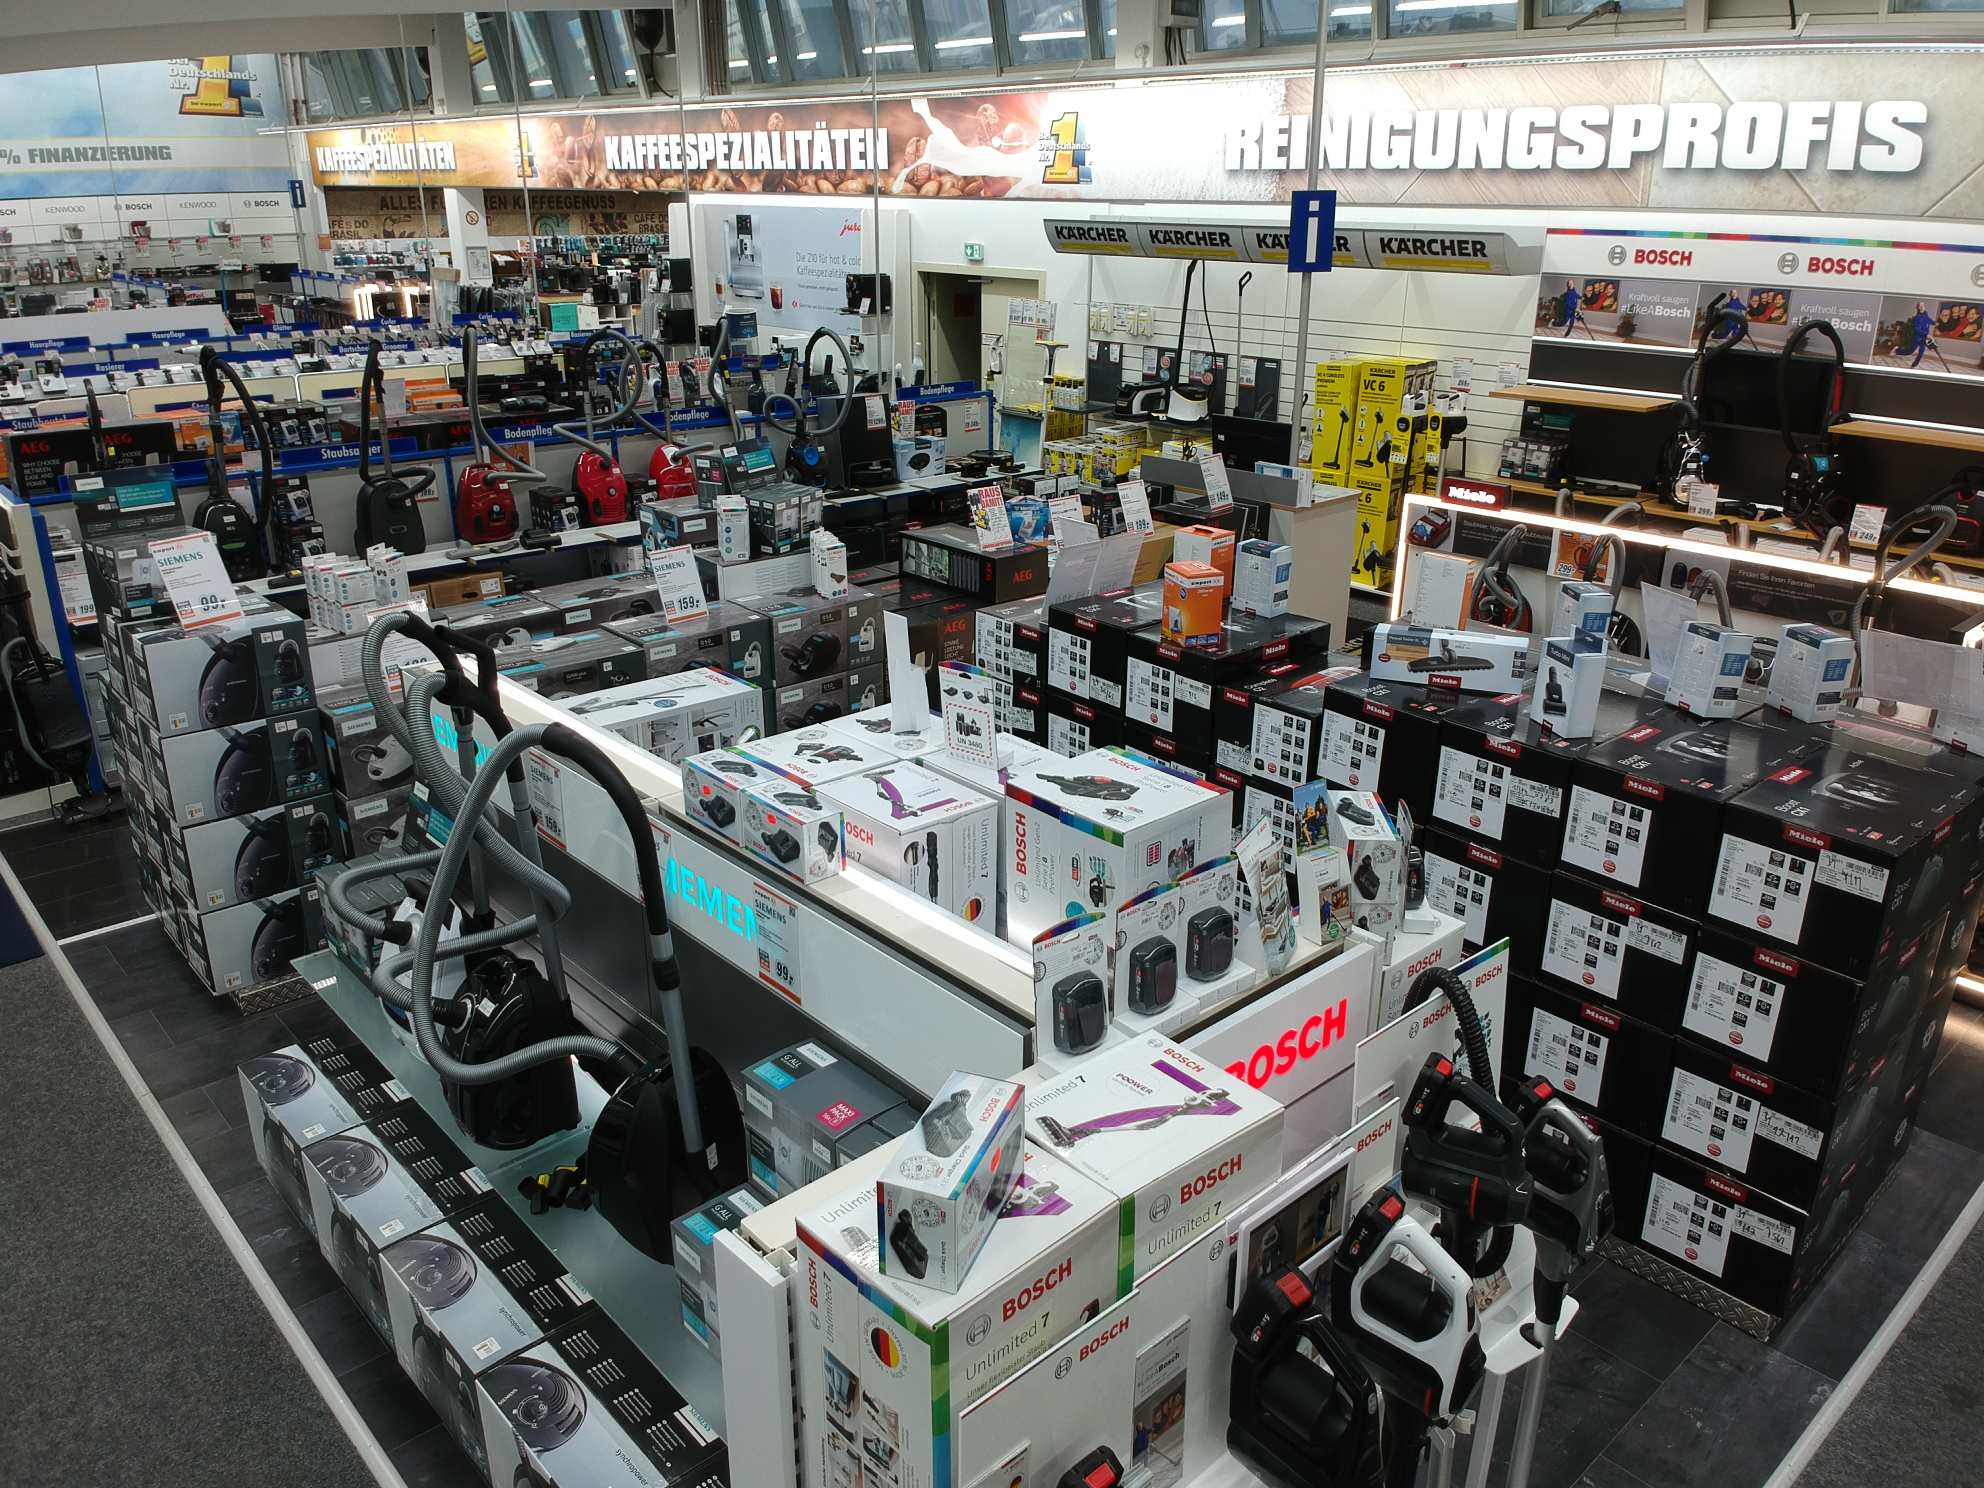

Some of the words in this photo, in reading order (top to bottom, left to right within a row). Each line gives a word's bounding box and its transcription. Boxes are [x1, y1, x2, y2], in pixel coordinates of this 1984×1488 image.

[168, 65, 258, 81] Deutschlands
[169, 79, 191, 91] Nr.
[1225, 99, 1928, 173] REINIGUNGSPROFIS
[29, 144, 172, 164] FINANZIERUNG
[605, 120, 889, 171] KAFFEESPEZIALITÄTEN
[315, 137, 458, 173] KAFFEESPEZIALITÄTEN
[45, 205, 85, 214] KENWOOD
[125, 203, 153, 211] BOSCH
[179, 201, 217, 210] KENWOOD
[254, 200, 280, 208] BOSCH
[1055, 224, 1129, 244] KÄRCHER
[1149, 228, 1233, 249] KÄRCHER
[1256, 231, 1352, 254] KÄER
[1380, 236, 1488, 258] KÄRCHER
[1634, 248, 1694, 267] BOSCH
[1807, 256, 1876, 277] BOSCH
[1628, 293, 1662, 304] Kraftvoll
[1662, 296, 1689, 306] saugen
[1620, 303, 1692, 319] #LikeABosch
[1800, 303, 1835, 315] Kraftvoll
[1837, 305, 1870, 318] saugen
[1370, 367, 1396, 375] KÄRCHER
[919, 384, 955, 396] Bodenpflege
[1363, 379, 1376, 391] VC
[1378, 380, 1386, 392] 6
[670, 410, 710, 422] odenpflege
[20, 441, 49, 454] AEG
[104, 434, 133, 445] AEG
[320, 444, 382, 461] Staubsager
[23, 461, 37, 469] WHY
[37, 459, 60, 467] CHOOSE
[978, 486, 1001, 498] RAUS
[1448, 486, 1496, 504] Miele
[157, 551, 204, 568] SIEMENS
[654, 560, 686, 574] SIEMENS
[1012, 568, 1033, 582] AEG
[944, 620, 967, 634] AEG
[1077, 618, 1096, 630] Miele
[1021, 628, 1039, 640] Miele
[1159, 648, 1179, 659] Miele
[1265, 643, 1287, 656] Miele
[1270, 663, 1294, 674] Miele
[1431, 677, 1458, 687] Miele
[1226, 691, 1248, 704] Miele
[1075, 706, 1093, 717] Miele
[1366, 703, 1392, 717] Miele
[347, 721, 372, 731] SIEMENS
[1631, 726, 1654, 740] Miele
[957, 737, 967, 745] UN
[1154, 739, 1173, 751] Miele
[1488, 740, 1517, 754] Miele
[1108, 756, 1141, 773] BOSCH
[1219, 771, 1239, 784] Miele
[1781, 768, 1803, 782] Miele
[1628, 780, 1659, 796] Miele
[845, 821, 874, 846] OSCH
[1789, 829, 1824, 848] Miele
[980, 817, 990, 872] Unlimited
[1016, 812, 1027, 876] BOSCH
[1471, 848, 1499, 865] Miele
[755, 898, 787, 925] SIEMENS
[1606, 894, 1636, 914] Miele
[1408, 947, 1442, 978] BOSCH
[1758, 951, 1793, 973] Miele
[1475, 963, 1503, 987] BOSCH
[1422, 1005, 1452, 1029] BOSCH
[1584, 1007, 1615, 1026] Miele
[1225, 997, 1348, 1090] BOSCH
[1163, 1047, 1205, 1073] BOSCH
[1074, 1074, 1087, 1084] 7
[1734, 1069, 1768, 1090] Miele
[979, 1097, 1001, 1122] BOSCH
[1356, 1119, 1393, 1153] BOSCH
[1180, 1152, 1243, 1206] BOSCH
[1708, 1175, 1742, 1199] Miele
[821, 1187, 879, 1226] Unlimite
[1148, 1209, 1211, 1255] Unlimited
[1213, 1200, 1222, 1216] 7
[808, 1258, 817, 1309] BOSCH
[823, 1270, 832, 1281] 7
[1002, 1256, 1072, 1323] BOSCH
[500, 1306, 527, 1337] synchropower
[823, 1282, 834, 1344] Unlimited
[965, 1321, 1037, 1382] Unlimited
[1041, 1311, 1050, 1329] 7
[1079, 1316, 1130, 1362] BOSCH
[615, 1448, 649, 1487] synchropower
